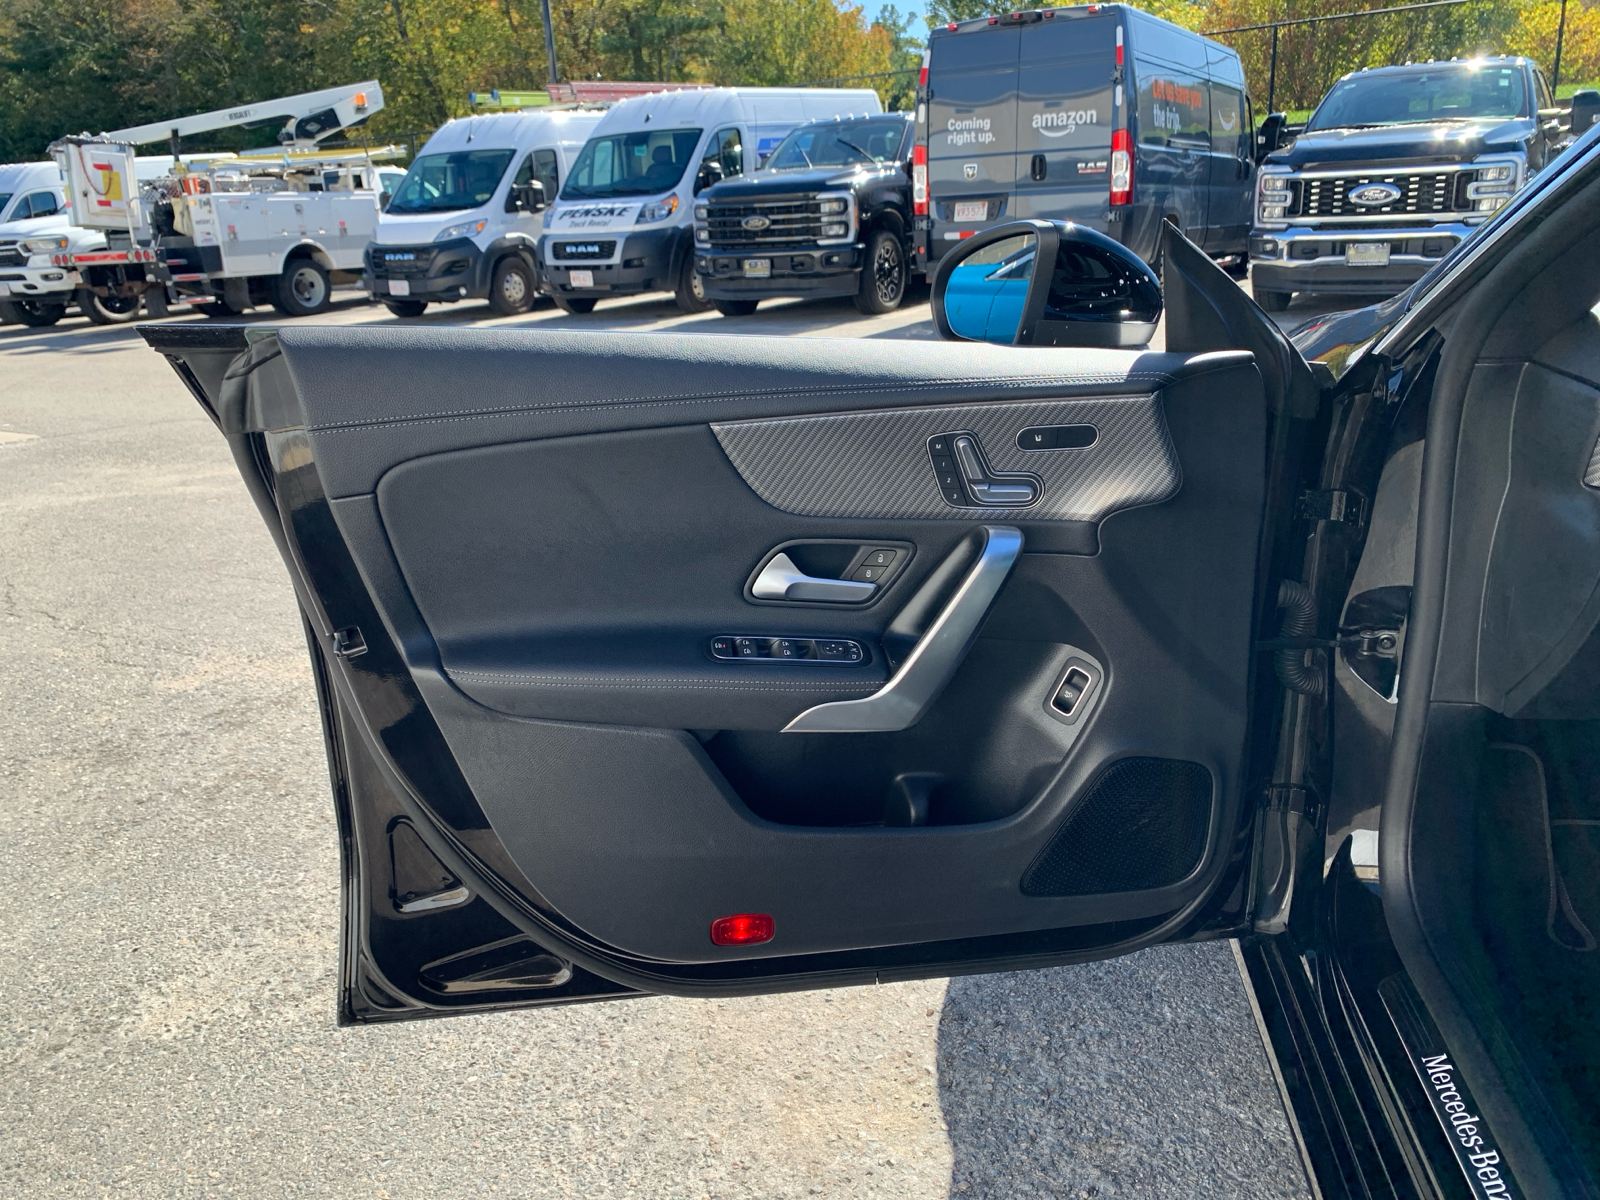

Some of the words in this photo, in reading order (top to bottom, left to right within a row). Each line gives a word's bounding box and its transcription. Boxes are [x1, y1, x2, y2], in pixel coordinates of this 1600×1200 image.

[1032, 109, 1097, 129] amazon
[1153, 103, 1166, 129] the
[947, 116, 991, 131] Coming
[947, 131, 977, 146] right
[978, 131, 996, 145] up.
[559, 206, 634, 220] PENSKE
[568, 220, 587, 229] Truck
[587, 219, 612, 228] Rental
[565, 244, 600, 253] RAM
[384, 253, 415, 261] RAM
